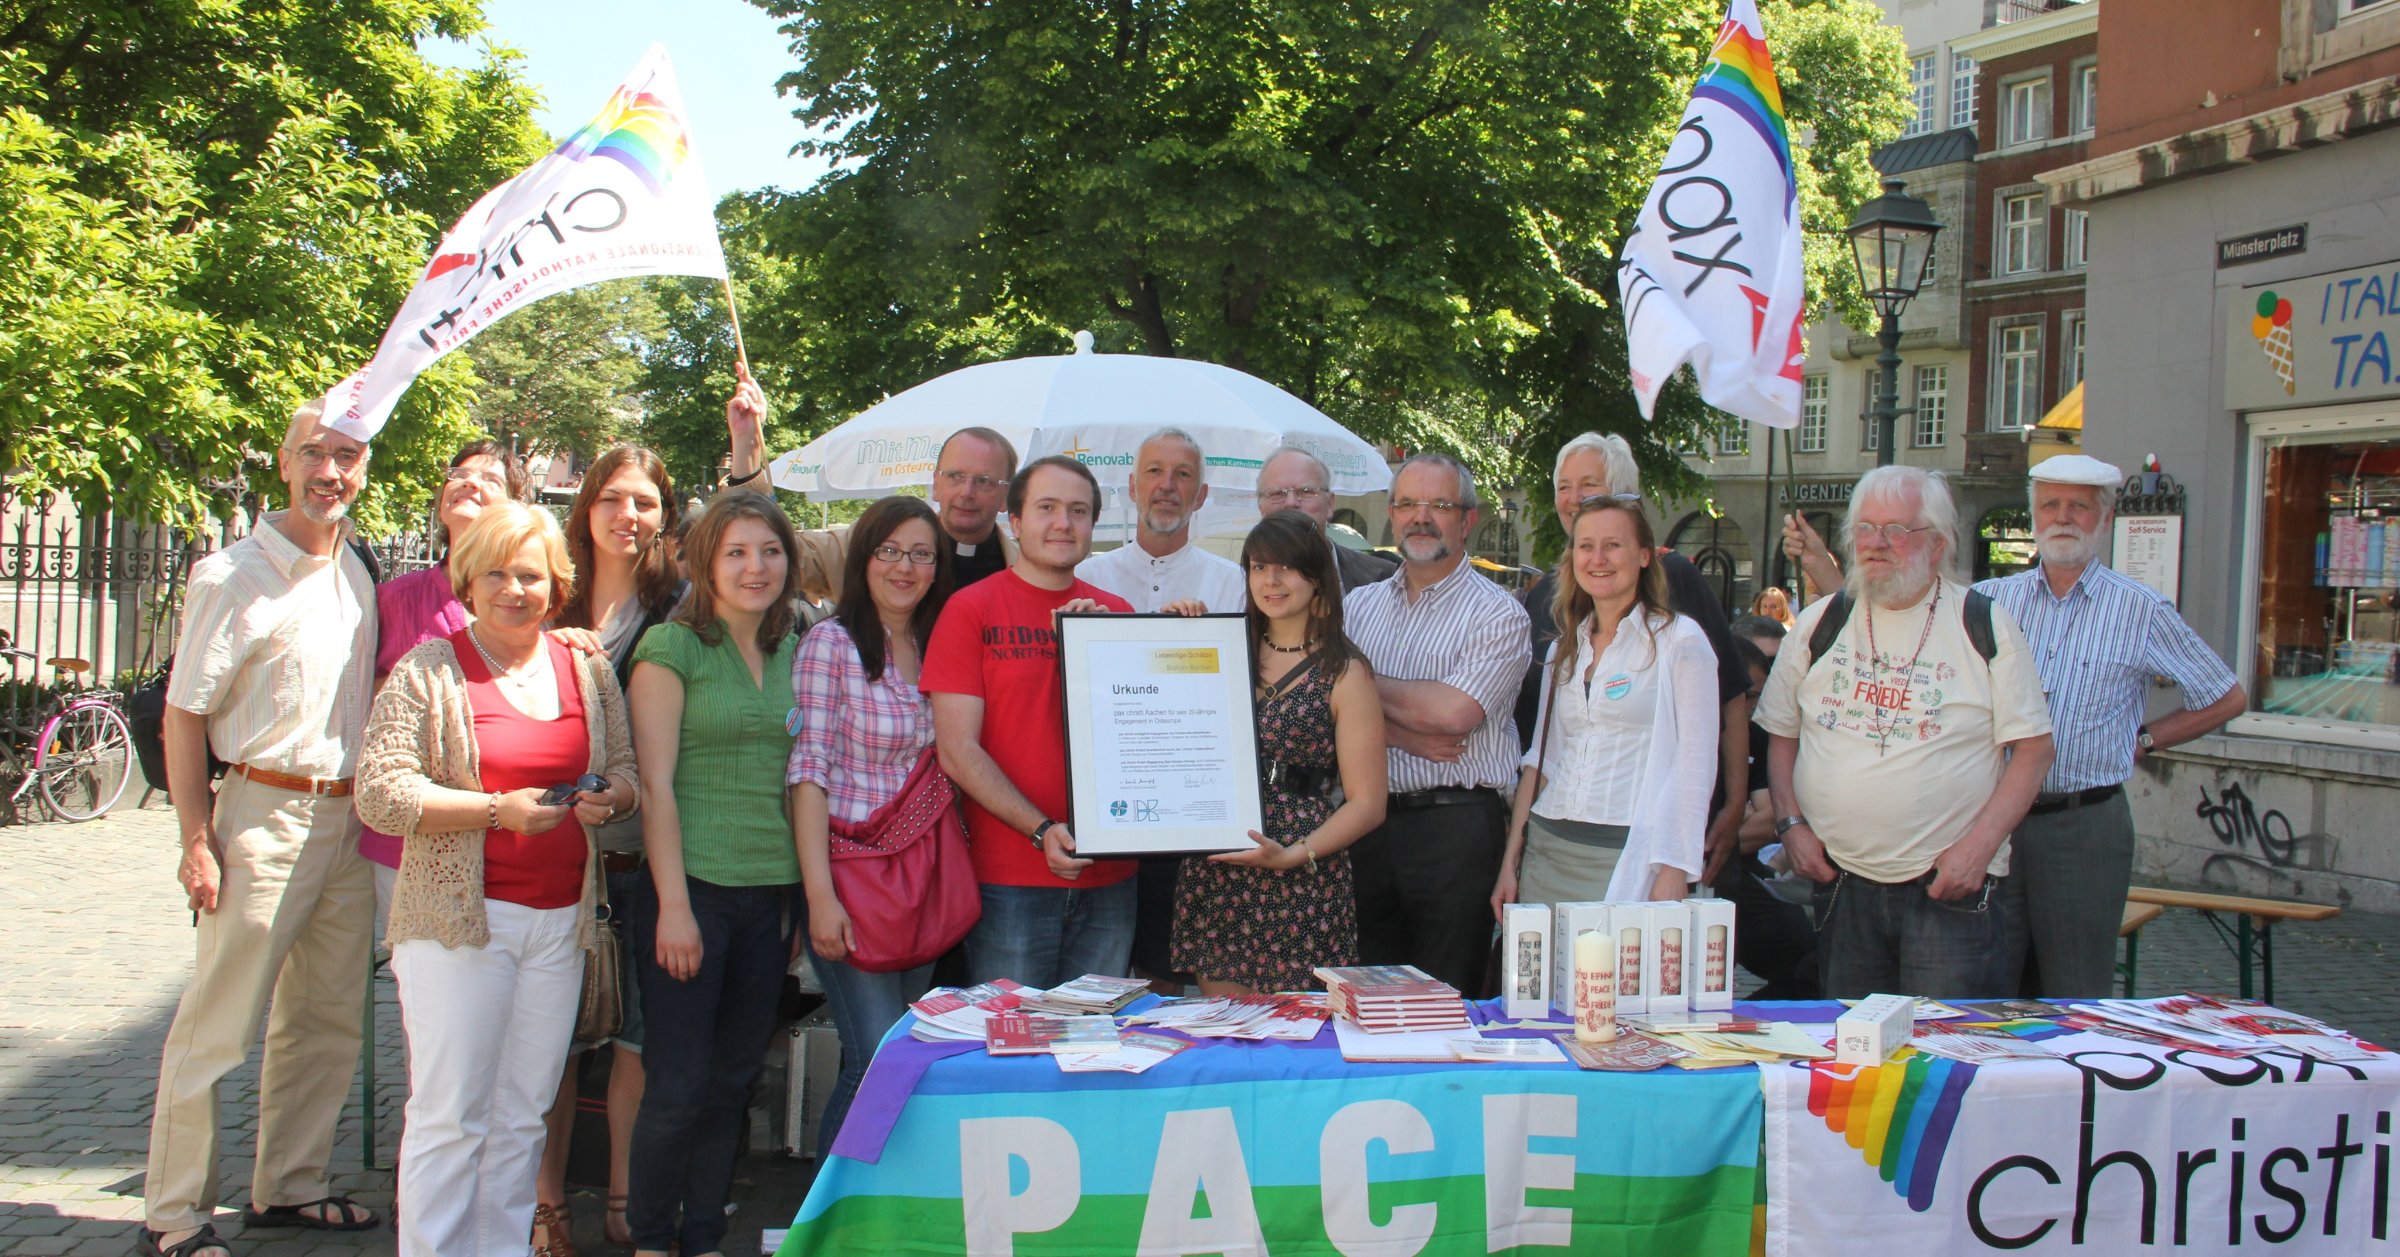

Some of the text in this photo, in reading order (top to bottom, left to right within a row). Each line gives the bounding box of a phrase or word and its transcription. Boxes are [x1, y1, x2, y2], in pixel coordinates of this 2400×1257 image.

[2223, 231, 2299, 260] Münsterplatz
[2320, 271, 2400, 325] ITAL
[1077, 452, 1134, 466] Renovab
[895, 461, 936, 475] Osteuro
[2128, 526, 2167, 534] Self-Service
[992, 647, 1057, 660] NORTHS
[1112, 683, 1159, 695] Urkunde
[1590, 985, 1611, 994] PEACE
[959, 1092, 1578, 1257] PACE
[1966, 1110, 2392, 1250] christi
